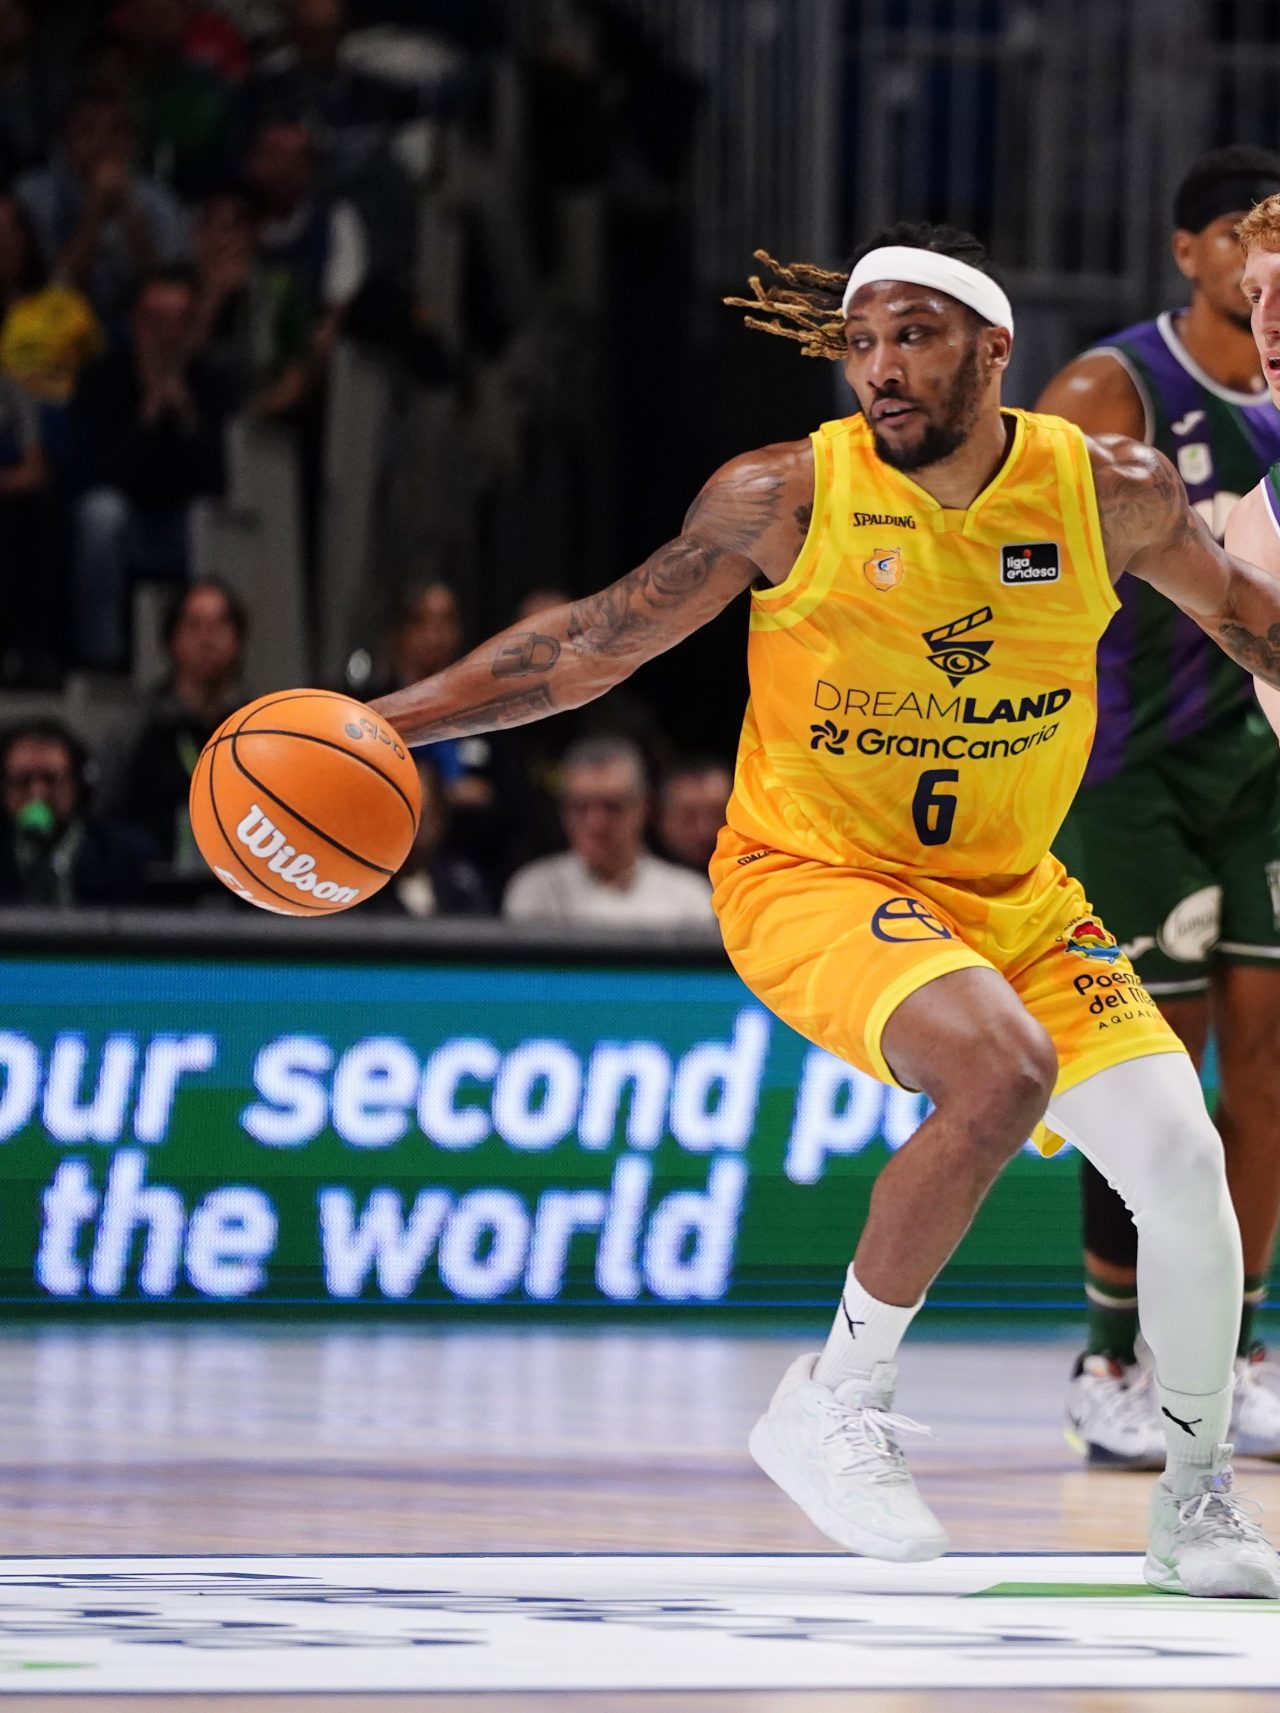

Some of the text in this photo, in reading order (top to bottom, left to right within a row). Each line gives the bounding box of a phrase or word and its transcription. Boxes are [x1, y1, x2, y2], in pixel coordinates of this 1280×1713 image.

[853, 512, 916, 529] SPALDING
[1006, 556, 1030, 569] liga
[1006, 566, 1056, 579] endesa
[813, 679, 1072, 725] DREAMLAND
[856, 721, 1060, 760] GranCanaria
[911, 768, 959, 847] 6
[236, 804, 360, 904] Wilson
[1089, 989, 1128, 1015] del
[242, 1010, 770, 1152] second
[37, 1150, 748, 1302] the world
